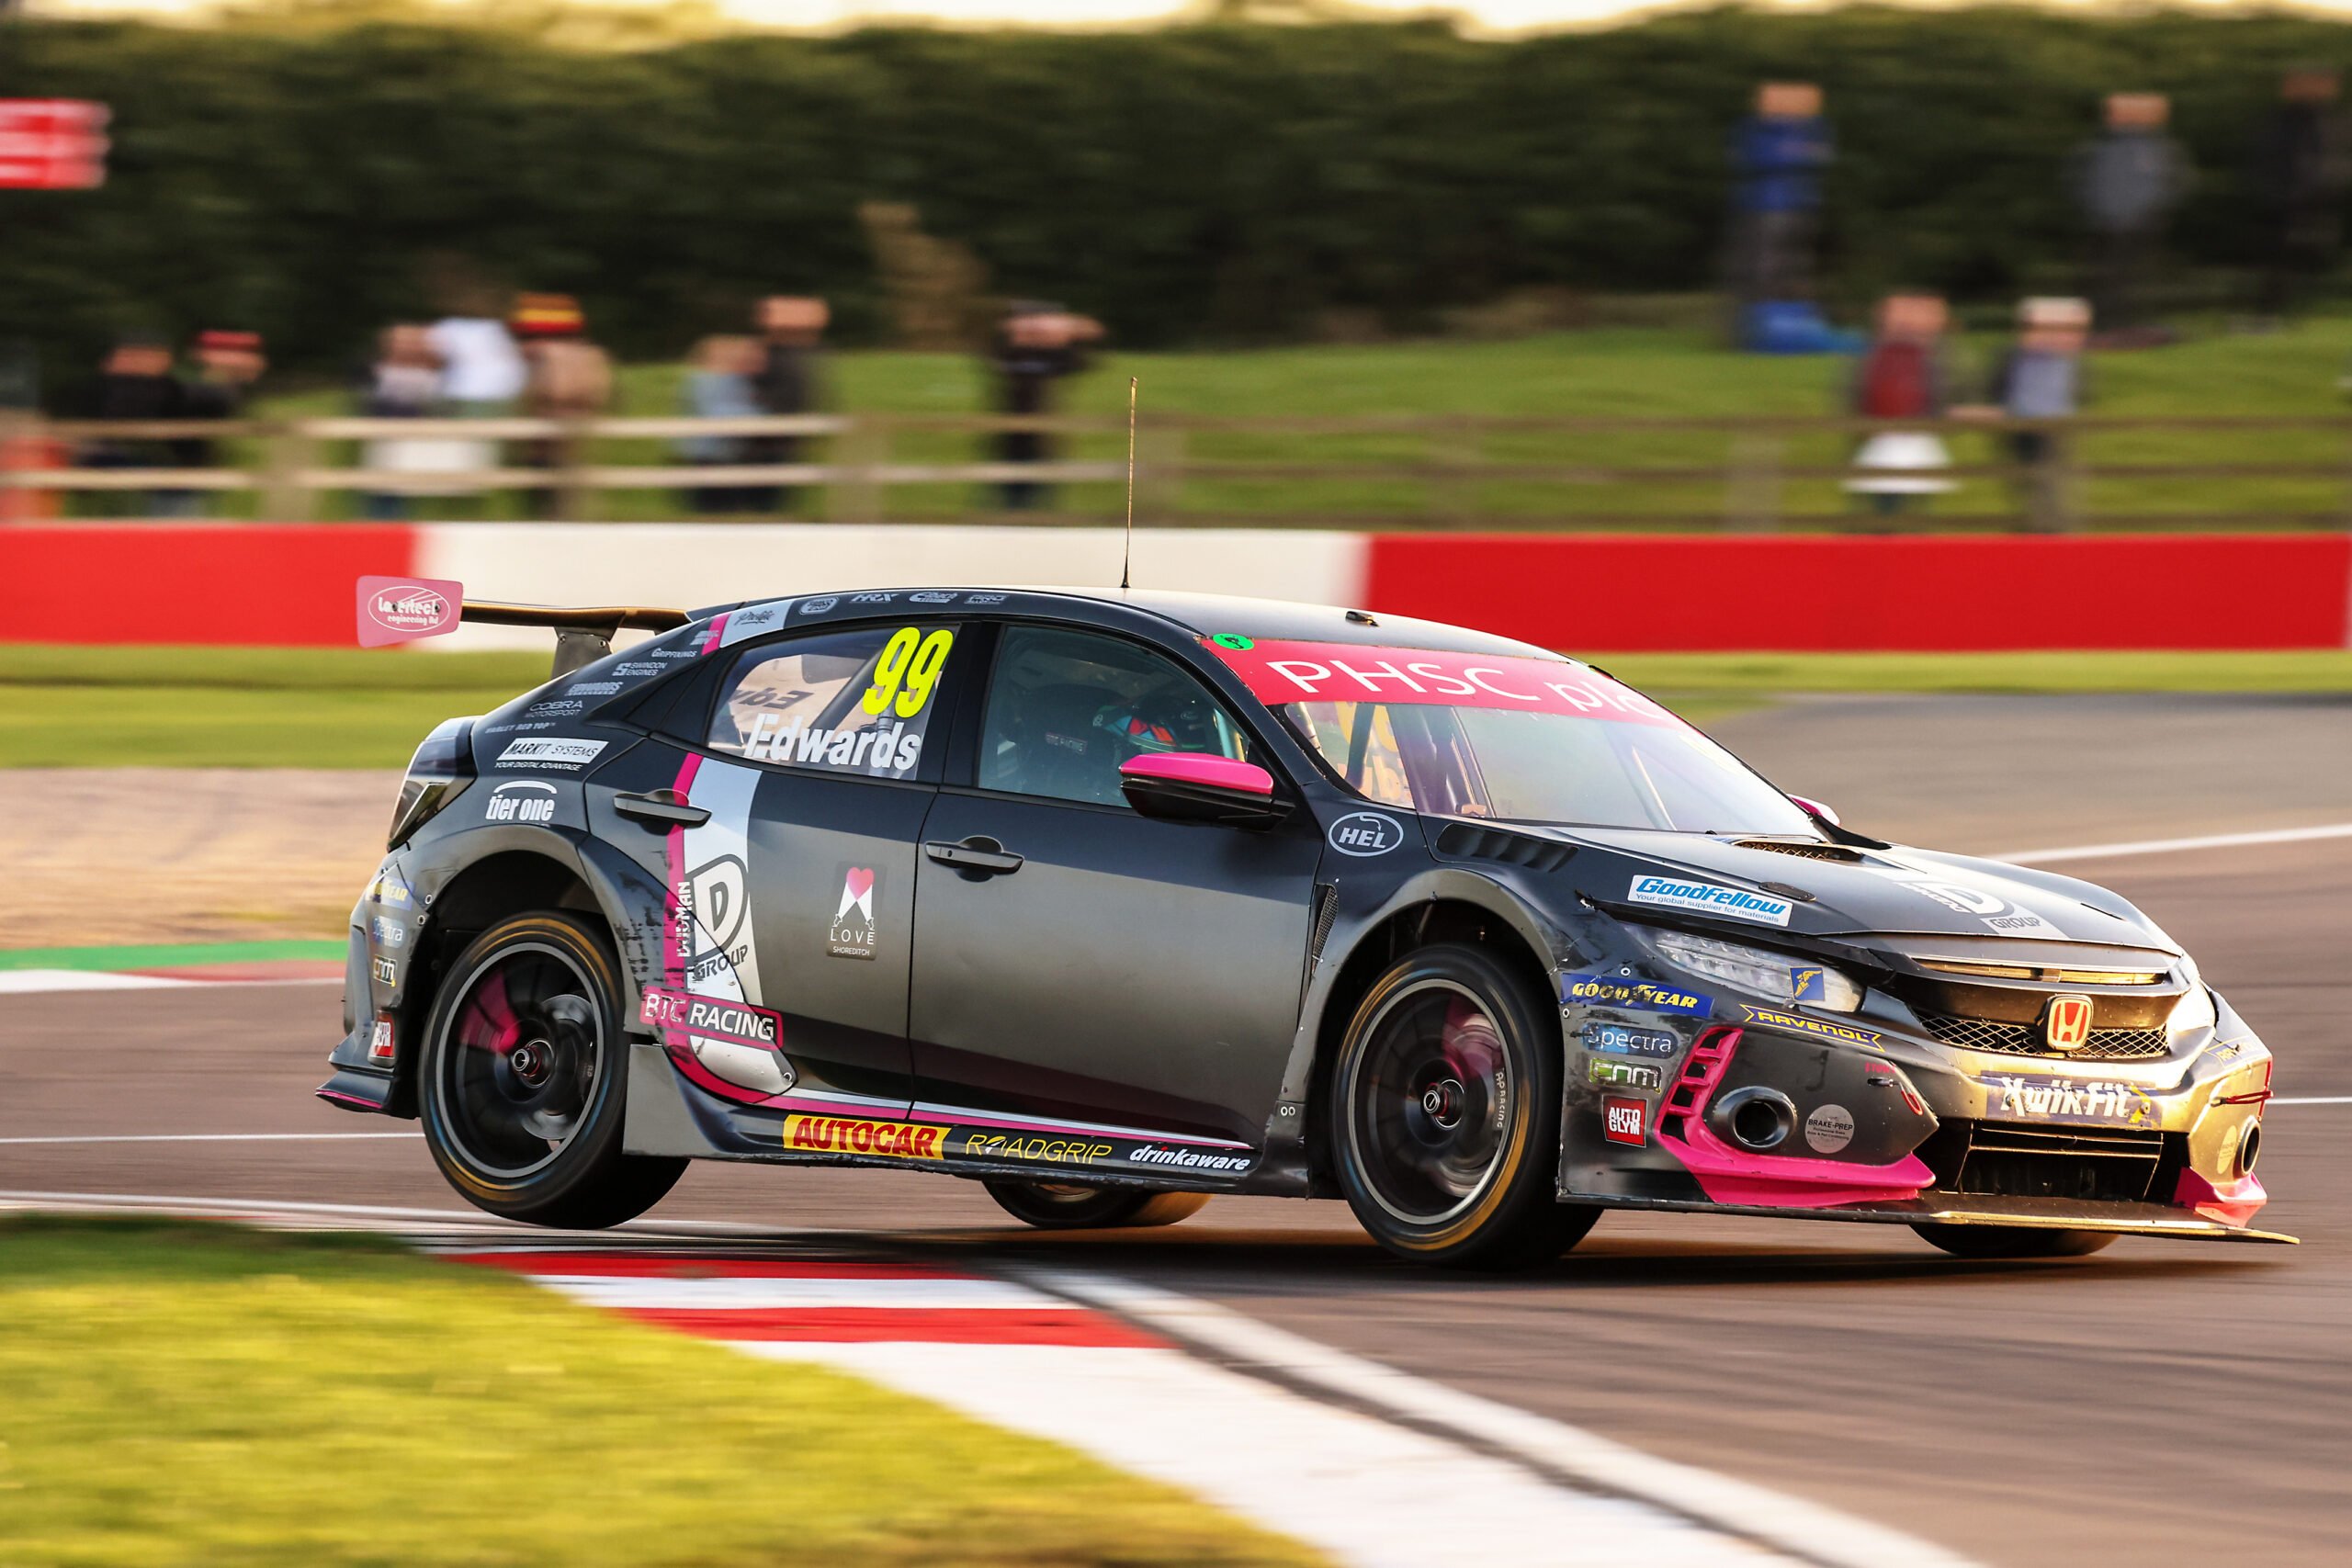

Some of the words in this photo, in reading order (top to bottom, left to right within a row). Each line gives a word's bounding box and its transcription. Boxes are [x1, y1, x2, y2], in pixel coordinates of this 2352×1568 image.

[862, 626, 954, 719] 99
[1265, 660, 1542, 701] PHSC
[1544, 681, 1666, 720] plc
[524, 709, 582, 718] MOTORSPORT
[529, 700, 583, 712] COBRA
[504, 742, 552, 755] MARKIT
[551, 745, 599, 757] SYSTEMS
[743, 713, 921, 771] Edwards
[538, 761, 583, 772] ADVANTAGE
[485, 794, 521, 820] tier
[518, 798, 555, 821] one
[1339, 826, 1386, 849] HEL
[1636, 893, 1657, 902] Your
[1657, 895, 1685, 906] global
[1687, 899, 1722, 911] supplier
[1724, 904, 1737, 914] for
[1738, 910, 1780, 923] materials
[1990, 917, 2041, 930] GROUP
[830, 928, 875, 945] LOVE
[694, 944, 749, 980] GROUP
[832, 945, 870, 956] SHOREDITCH
[644, 993, 686, 1022] BTC
[689, 1002, 774, 1041] RACING
[1757, 1011, 1870, 1043] RAVENOL
[1608, 1106, 1641, 1123] AUTO
[1808, 1118, 1853, 1131] BRAKE-PREP
[793, 1117, 938, 1157] AUTOCAR
[1608, 1118, 1641, 1135] GLYM
[1129, 1145, 1250, 1171] drinkaware
